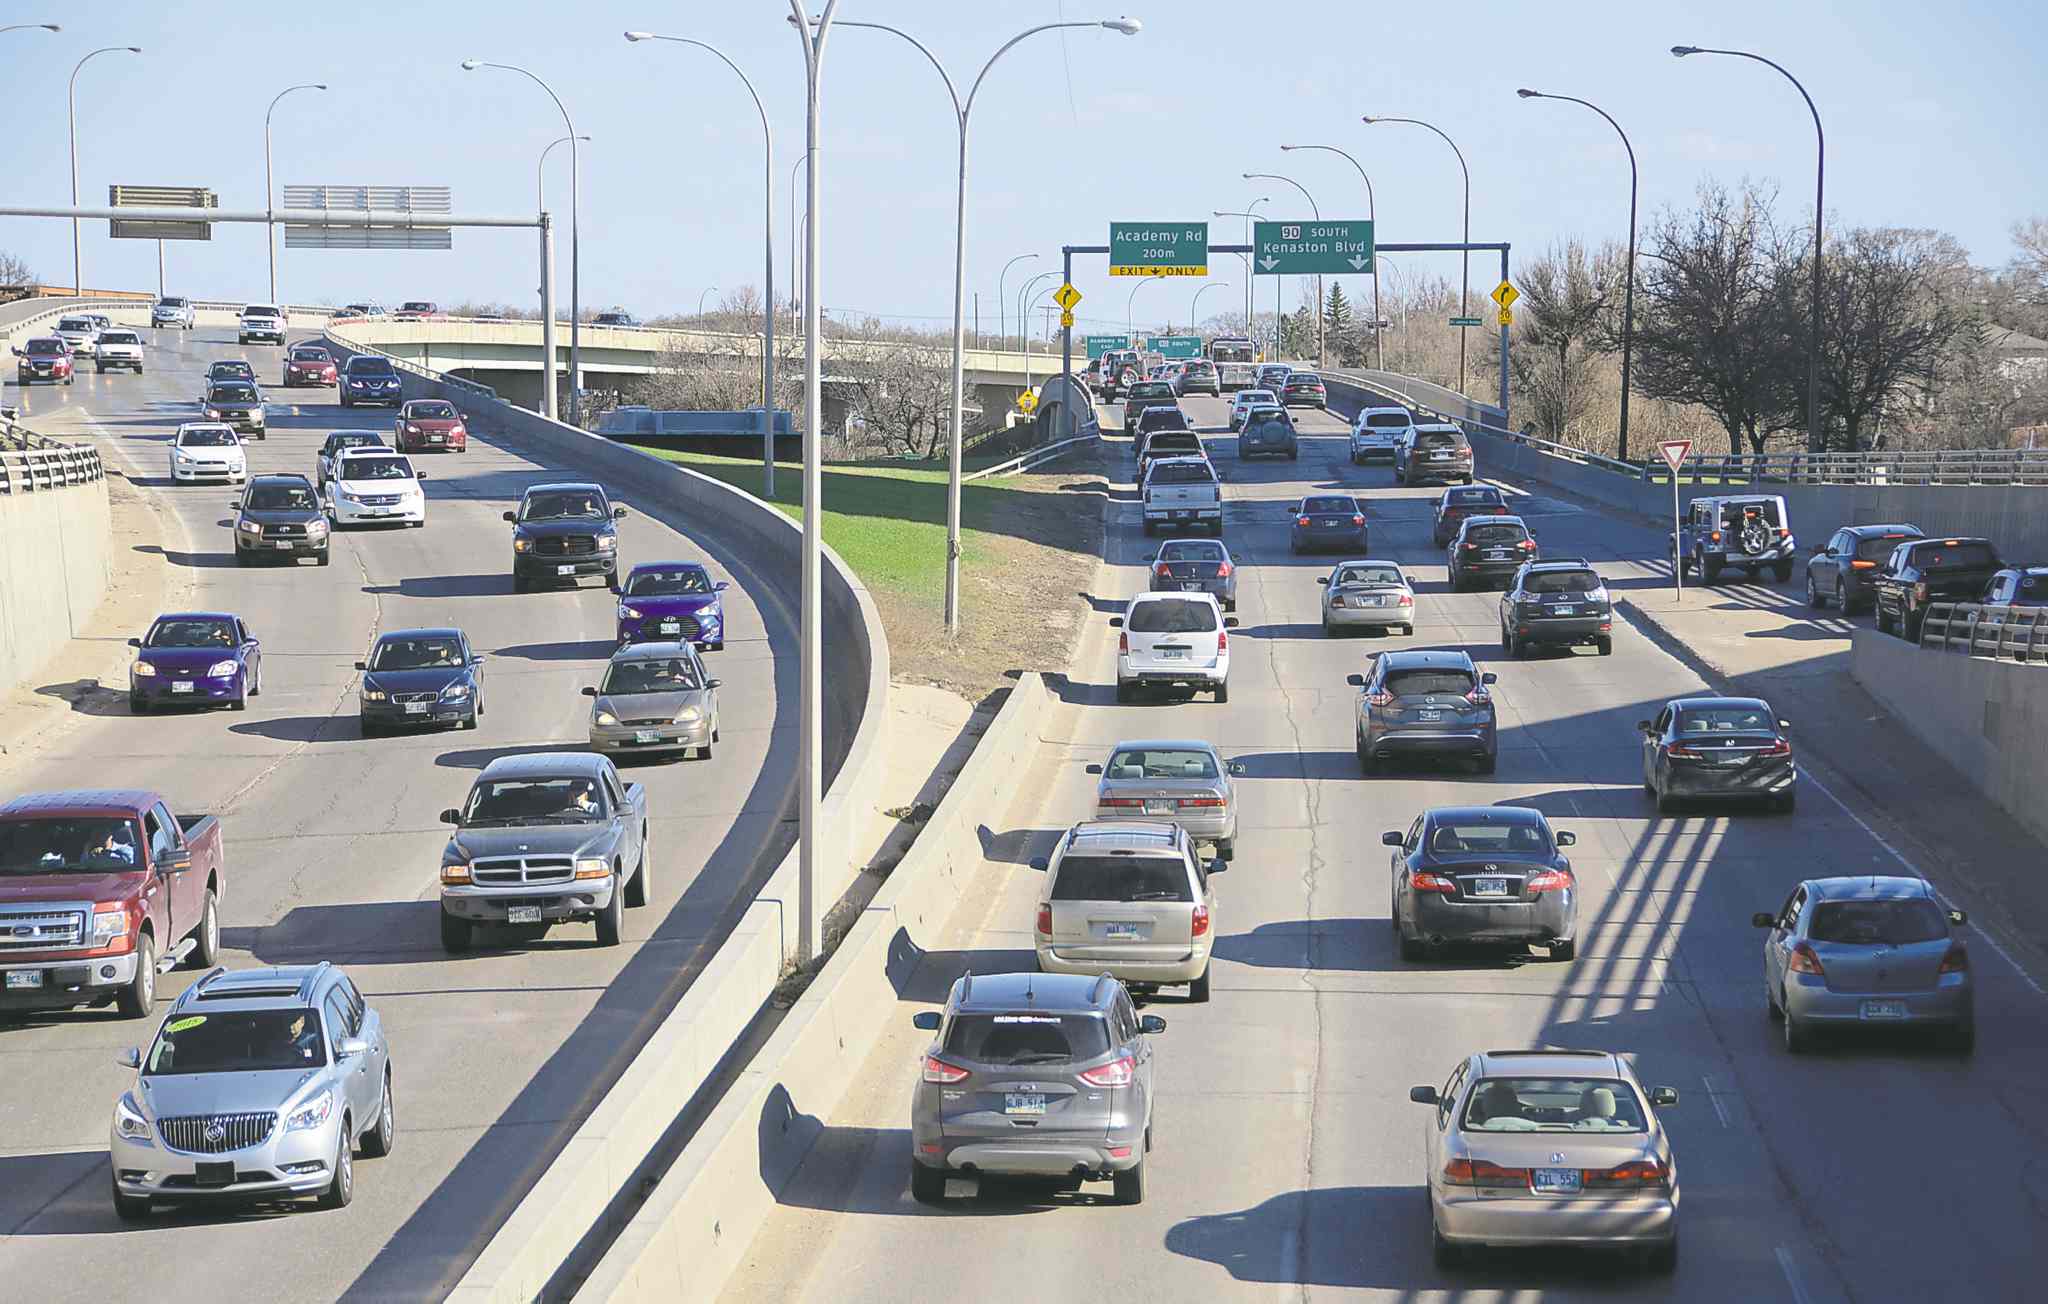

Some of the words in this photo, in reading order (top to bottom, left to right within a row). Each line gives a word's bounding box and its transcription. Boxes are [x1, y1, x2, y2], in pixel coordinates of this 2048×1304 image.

[1115, 230, 1179, 244] Academy
[1185, 230, 1203, 242] Rd
[1282, 227, 1299, 238] 90
[1311, 227, 1349, 237] SOUTH
[1263, 242, 1328, 253] Kenaston
[1335, 241, 1365, 253] Blvd
[1143, 248, 1176, 258] 200m
[1120, 267, 1144, 276] EXIT
[1166, 266, 1197, 276] ONLY
